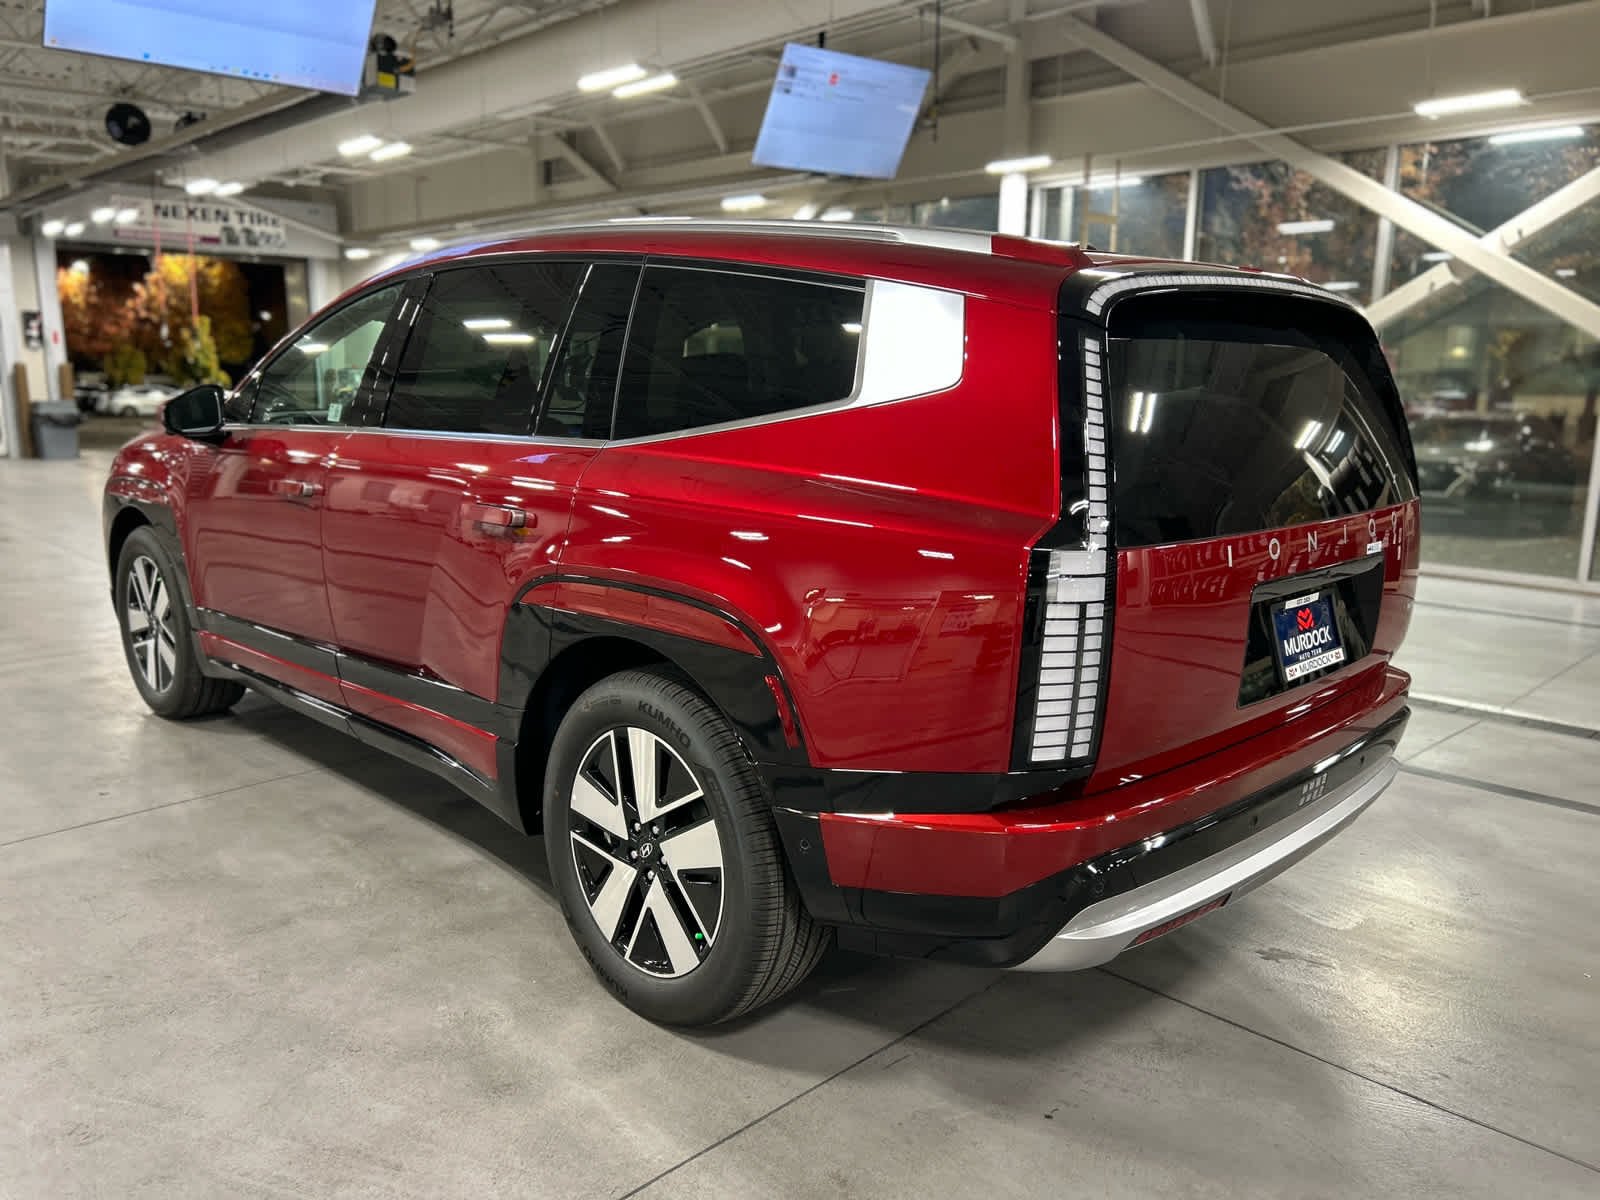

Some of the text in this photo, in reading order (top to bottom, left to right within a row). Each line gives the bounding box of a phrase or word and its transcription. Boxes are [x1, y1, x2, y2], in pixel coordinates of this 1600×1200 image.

[153, 203, 230, 222] NEXEN
[1227, 518, 1377, 568] IONIQ
[1284, 625, 1332, 657] MURDOCK
[1298, 653, 1332, 673] MURDOCK
[637, 700, 692, 748] KUMHO
